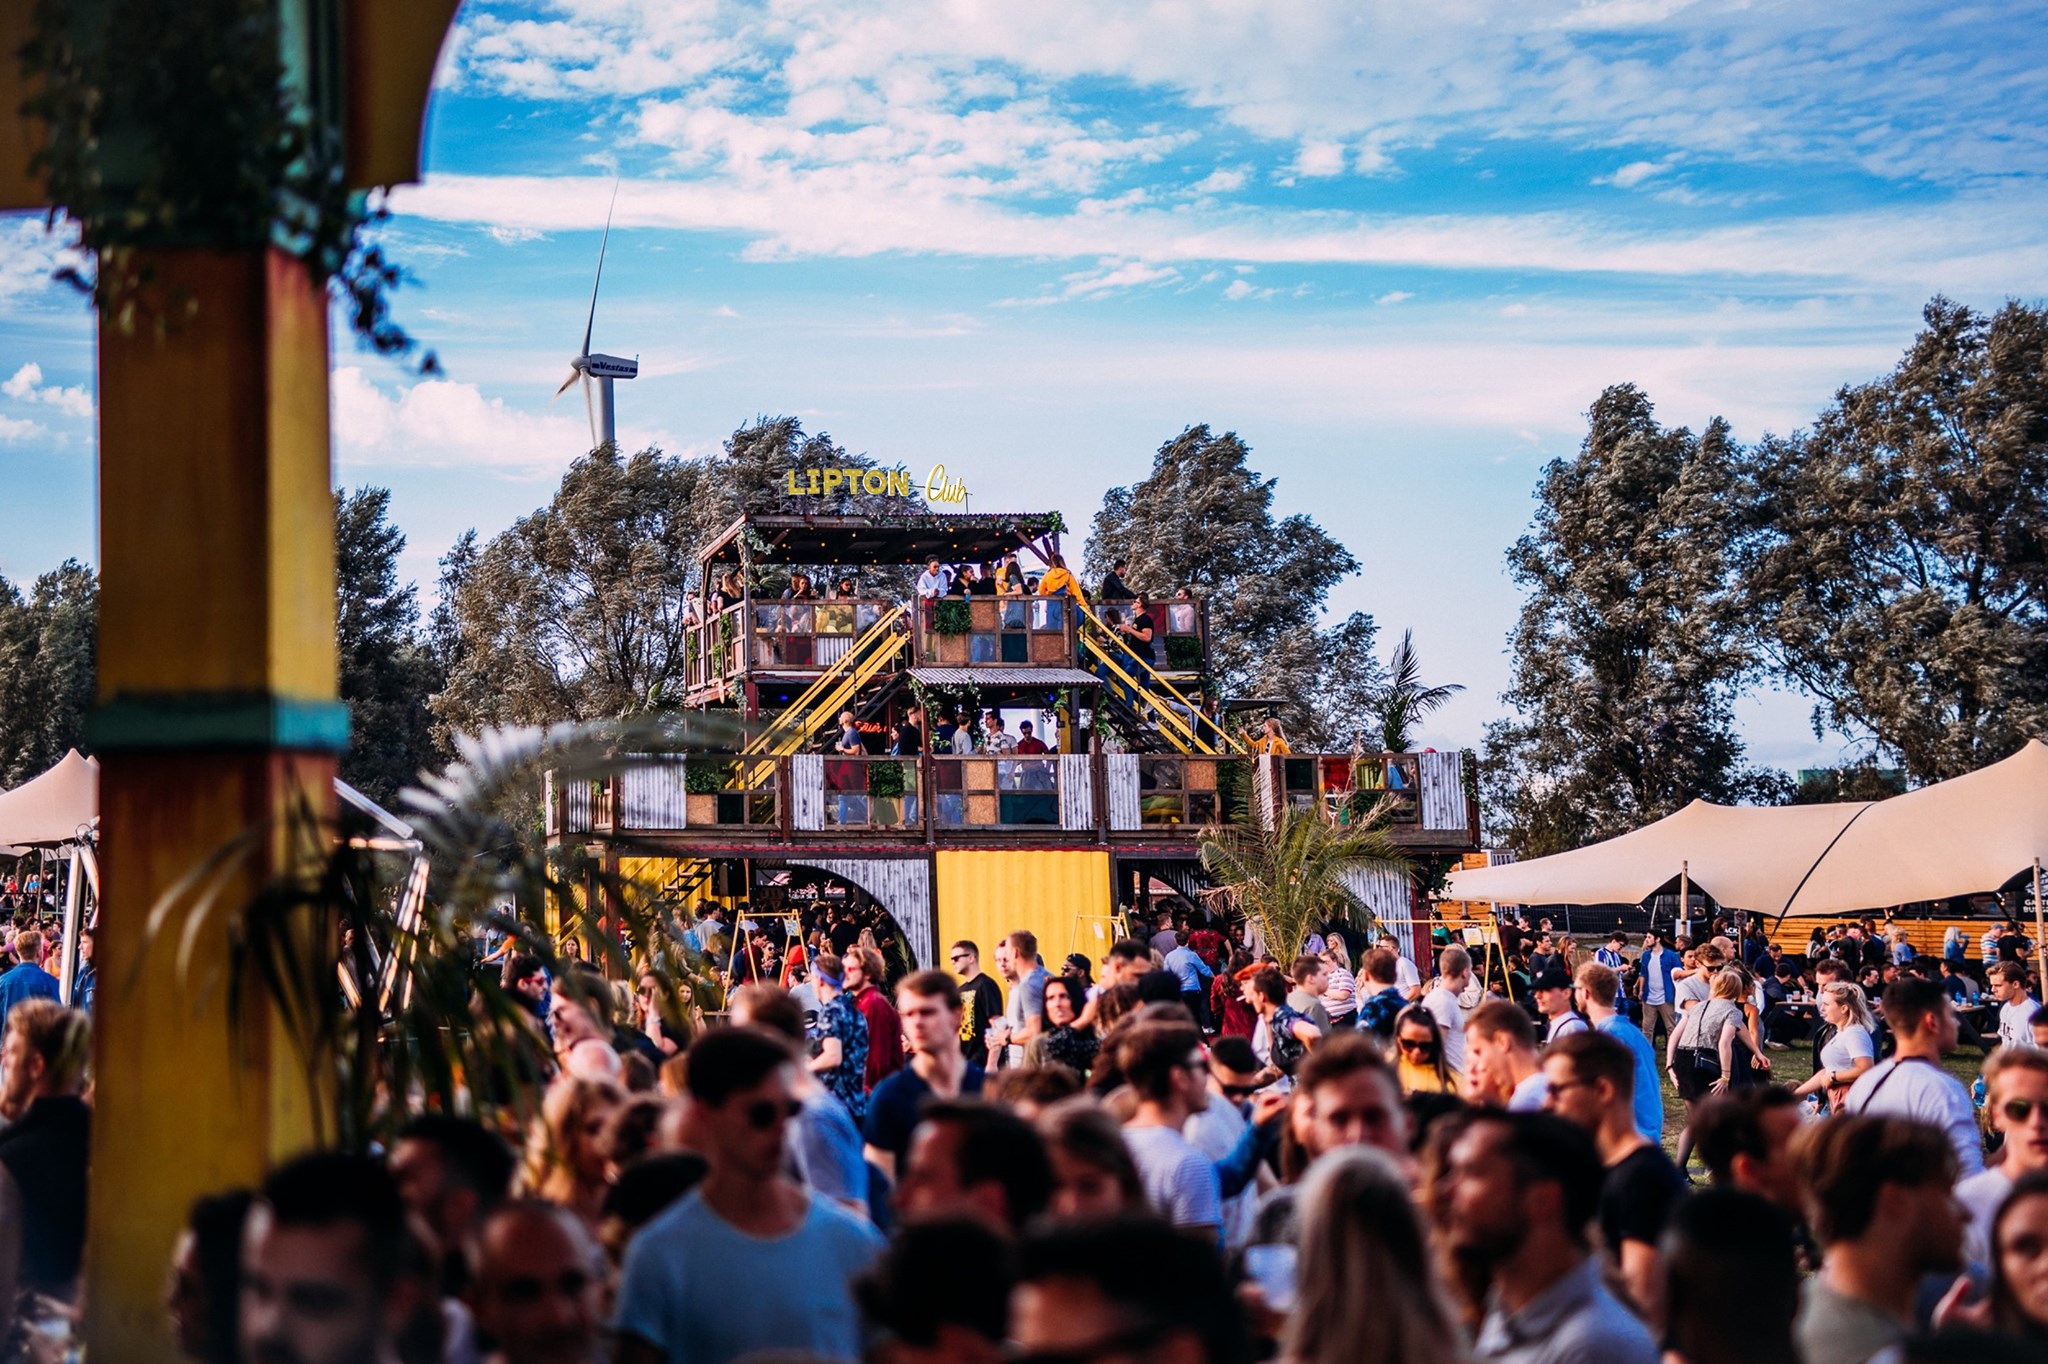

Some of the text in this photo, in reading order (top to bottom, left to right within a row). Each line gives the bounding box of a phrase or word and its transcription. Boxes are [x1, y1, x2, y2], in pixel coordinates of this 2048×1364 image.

[600, 361, 629, 373] Vestas
[788, 463, 967, 503] LIPTON Club
